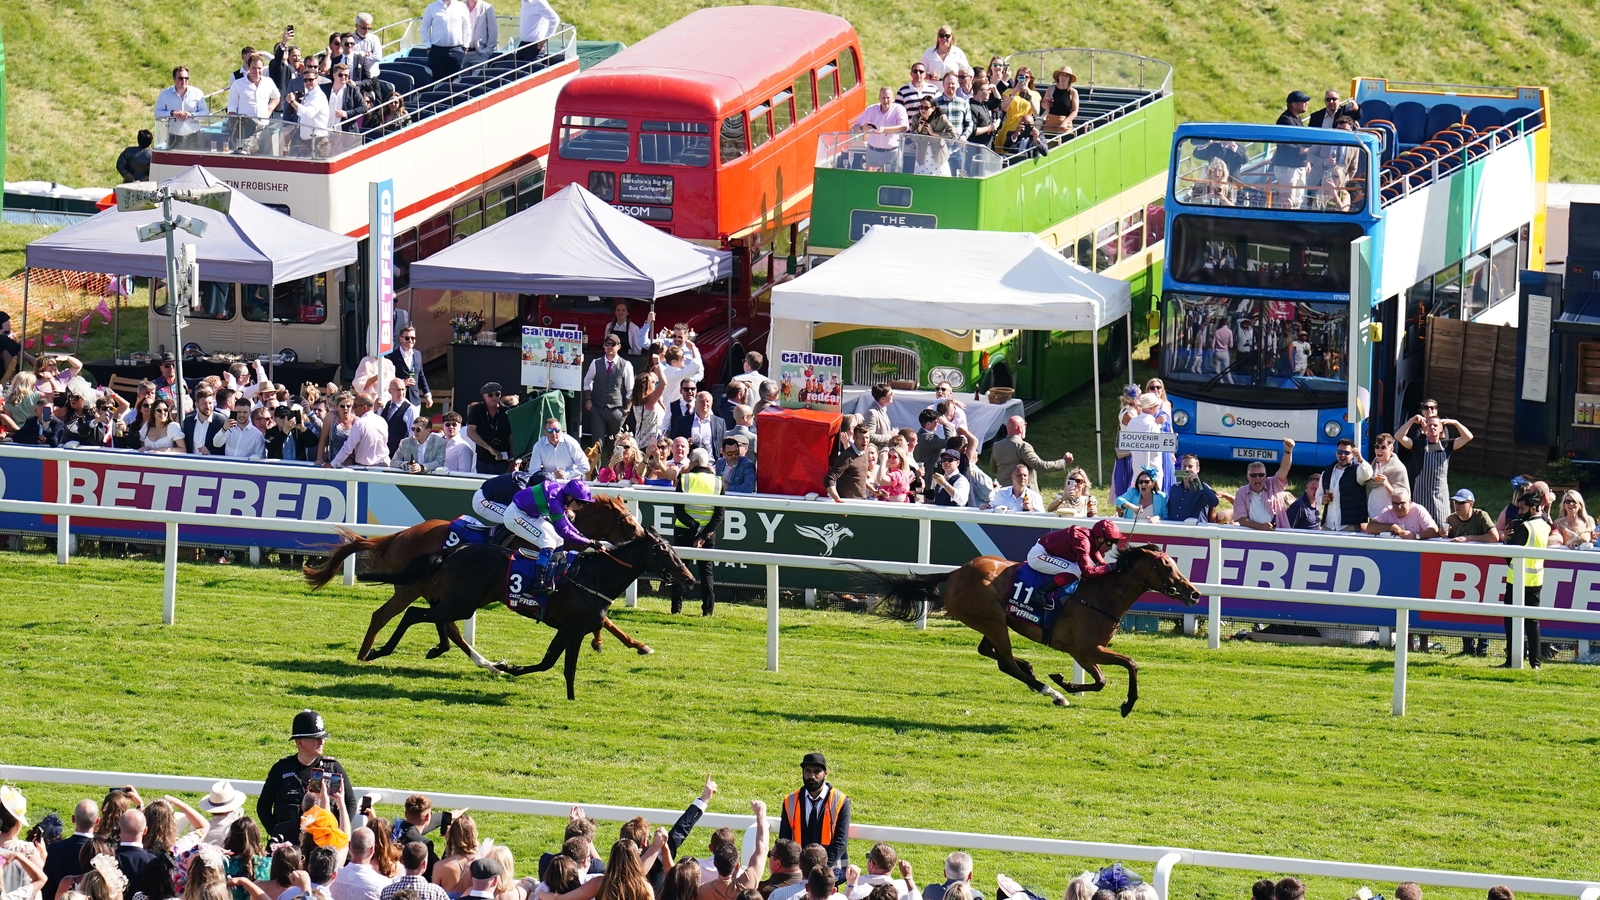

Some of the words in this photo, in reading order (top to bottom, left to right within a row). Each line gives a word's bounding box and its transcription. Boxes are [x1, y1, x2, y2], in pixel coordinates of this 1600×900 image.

[241, 181, 289, 192] FROBISHER
[652, 179, 662, 187] Big
[880, 215, 906, 225] THE
[380, 189, 392, 345] BETFRED
[806, 392, 841, 404] redcar
[1235, 417, 1290, 429] Stagecoach
[1121, 433, 1159, 442] SOUVENIR
[1162, 438, 1175, 448] £5
[1120, 441, 1160, 450] RACECARD
[1237, 449, 1255, 458] LX51
[1256, 450, 1273, 460] FON
[68, 467, 346, 522] BETFRED
[446, 531, 460, 547] 9
[509, 573, 523, 594] 3
[1013, 581, 1034, 604] 11
